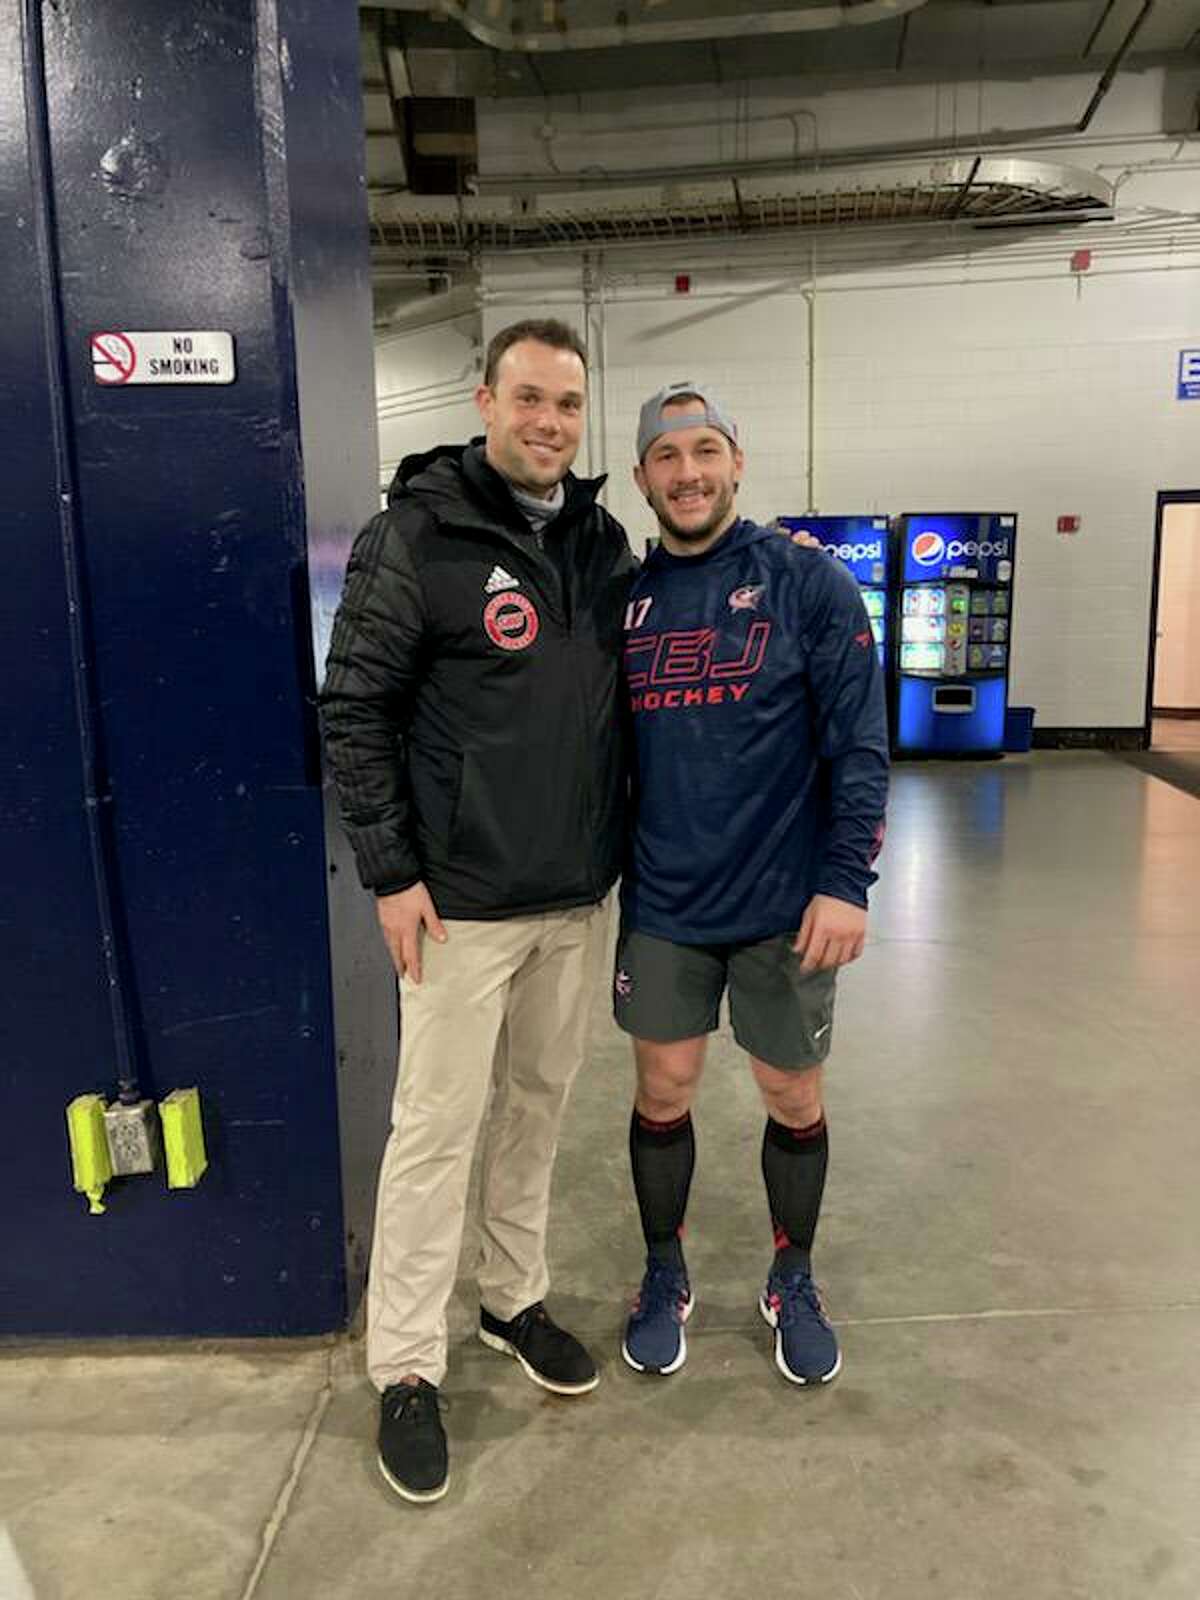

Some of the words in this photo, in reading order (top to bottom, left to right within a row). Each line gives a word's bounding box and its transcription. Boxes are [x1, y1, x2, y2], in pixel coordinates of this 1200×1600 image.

[173, 337, 193, 353] NO
[149, 358, 220, 375] SMOKING
[945, 538, 1009, 561] pepsi
